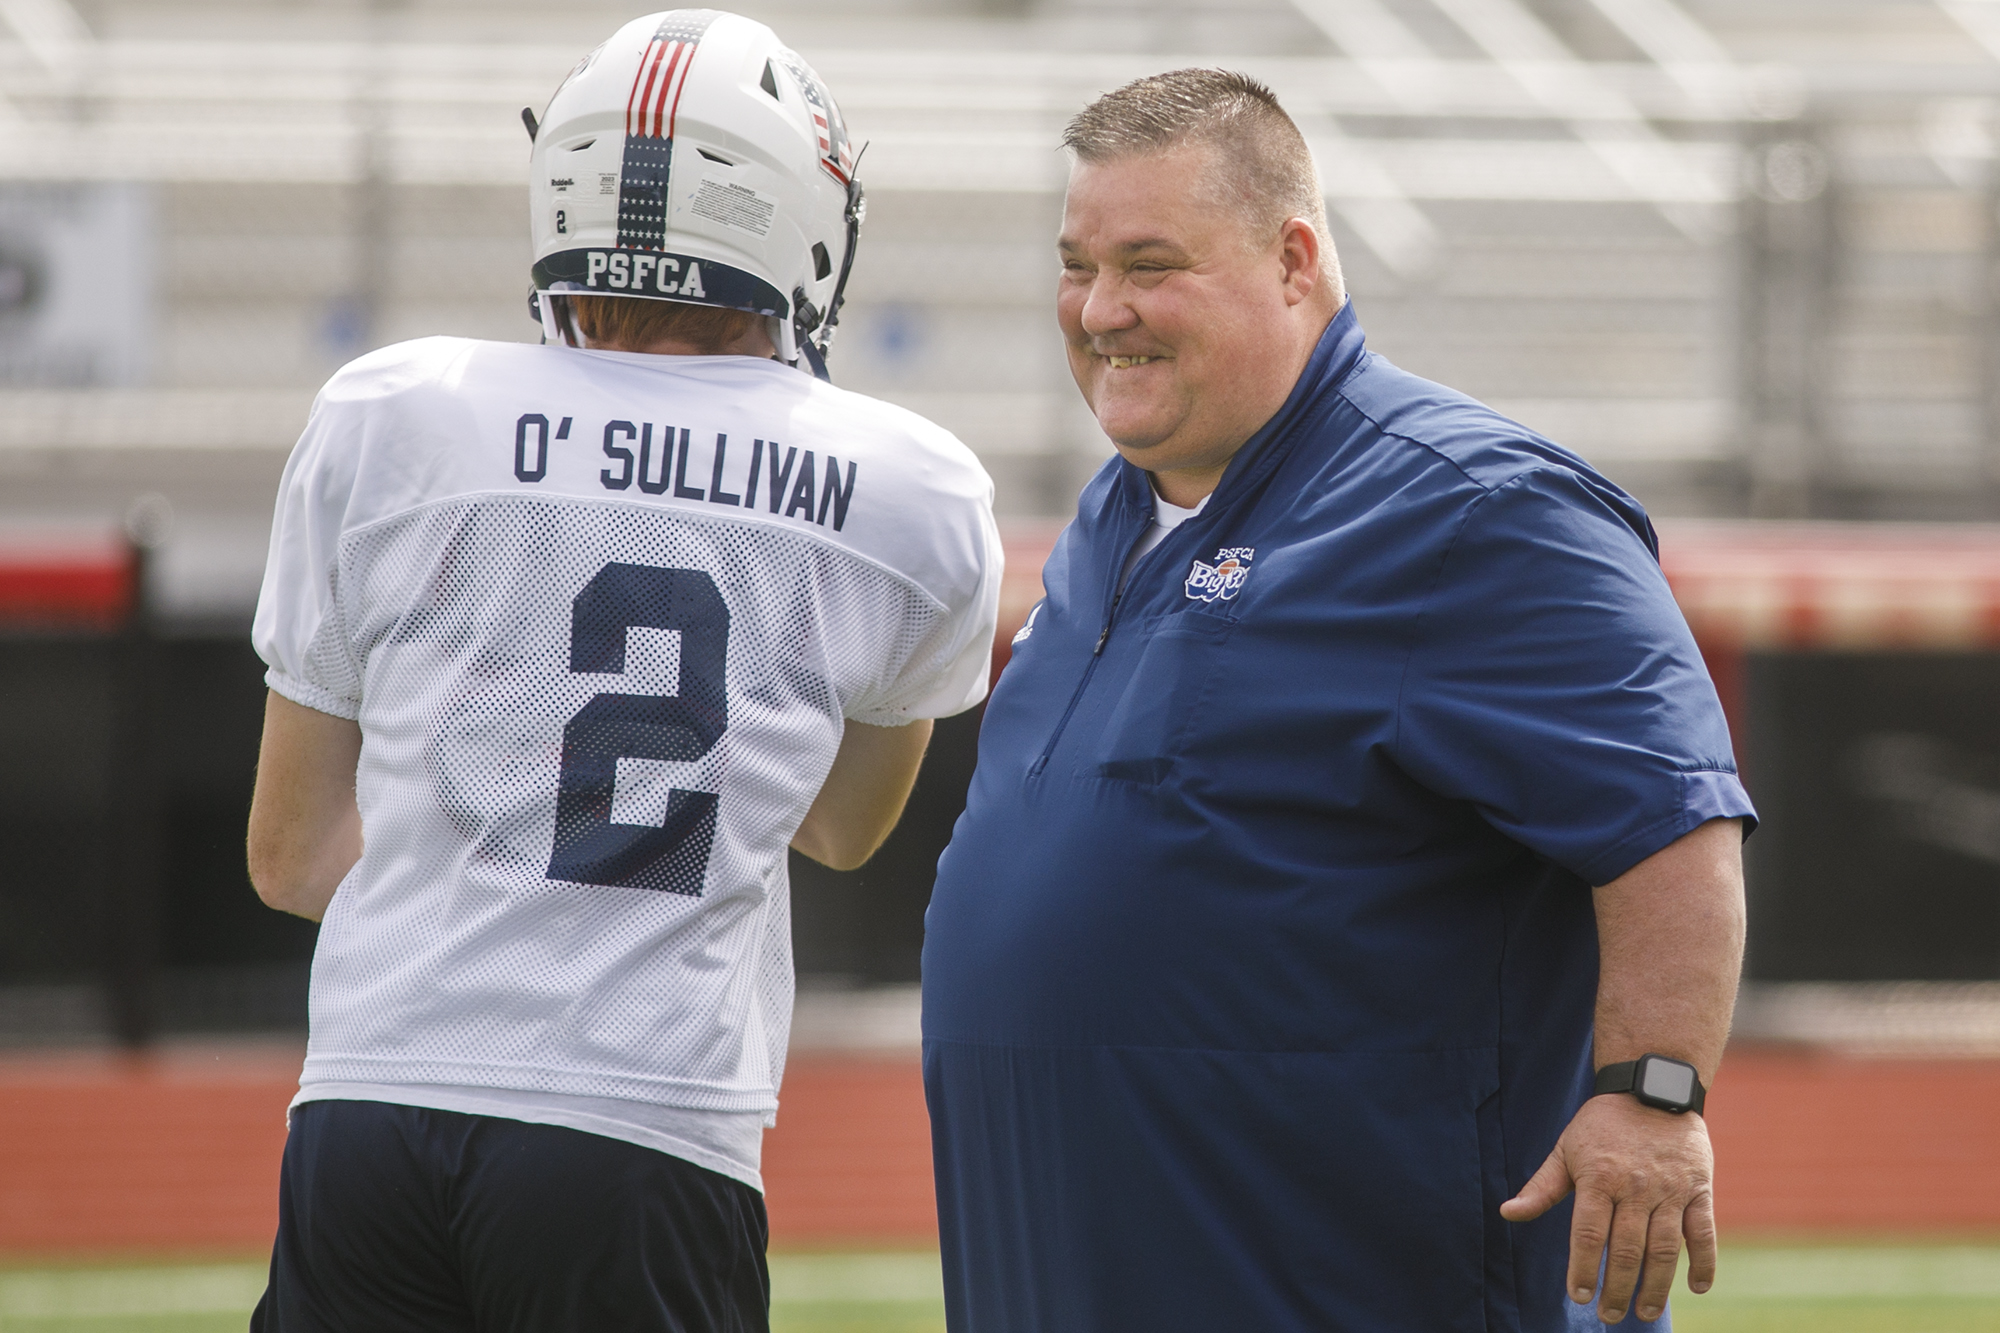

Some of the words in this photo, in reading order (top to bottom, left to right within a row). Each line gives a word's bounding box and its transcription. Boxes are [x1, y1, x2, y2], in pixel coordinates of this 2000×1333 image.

[728, 182, 756, 197] WARNING
[556, 210, 567, 234] 2
[586, 251, 706, 298] PSFCA
[514, 413, 573, 483] O'
[600, 419, 858, 533] SULLIVAN
[1214, 547, 1255, 561] PSFCA
[1188, 565, 1225, 593] Big
[545, 561, 731, 898] 2
